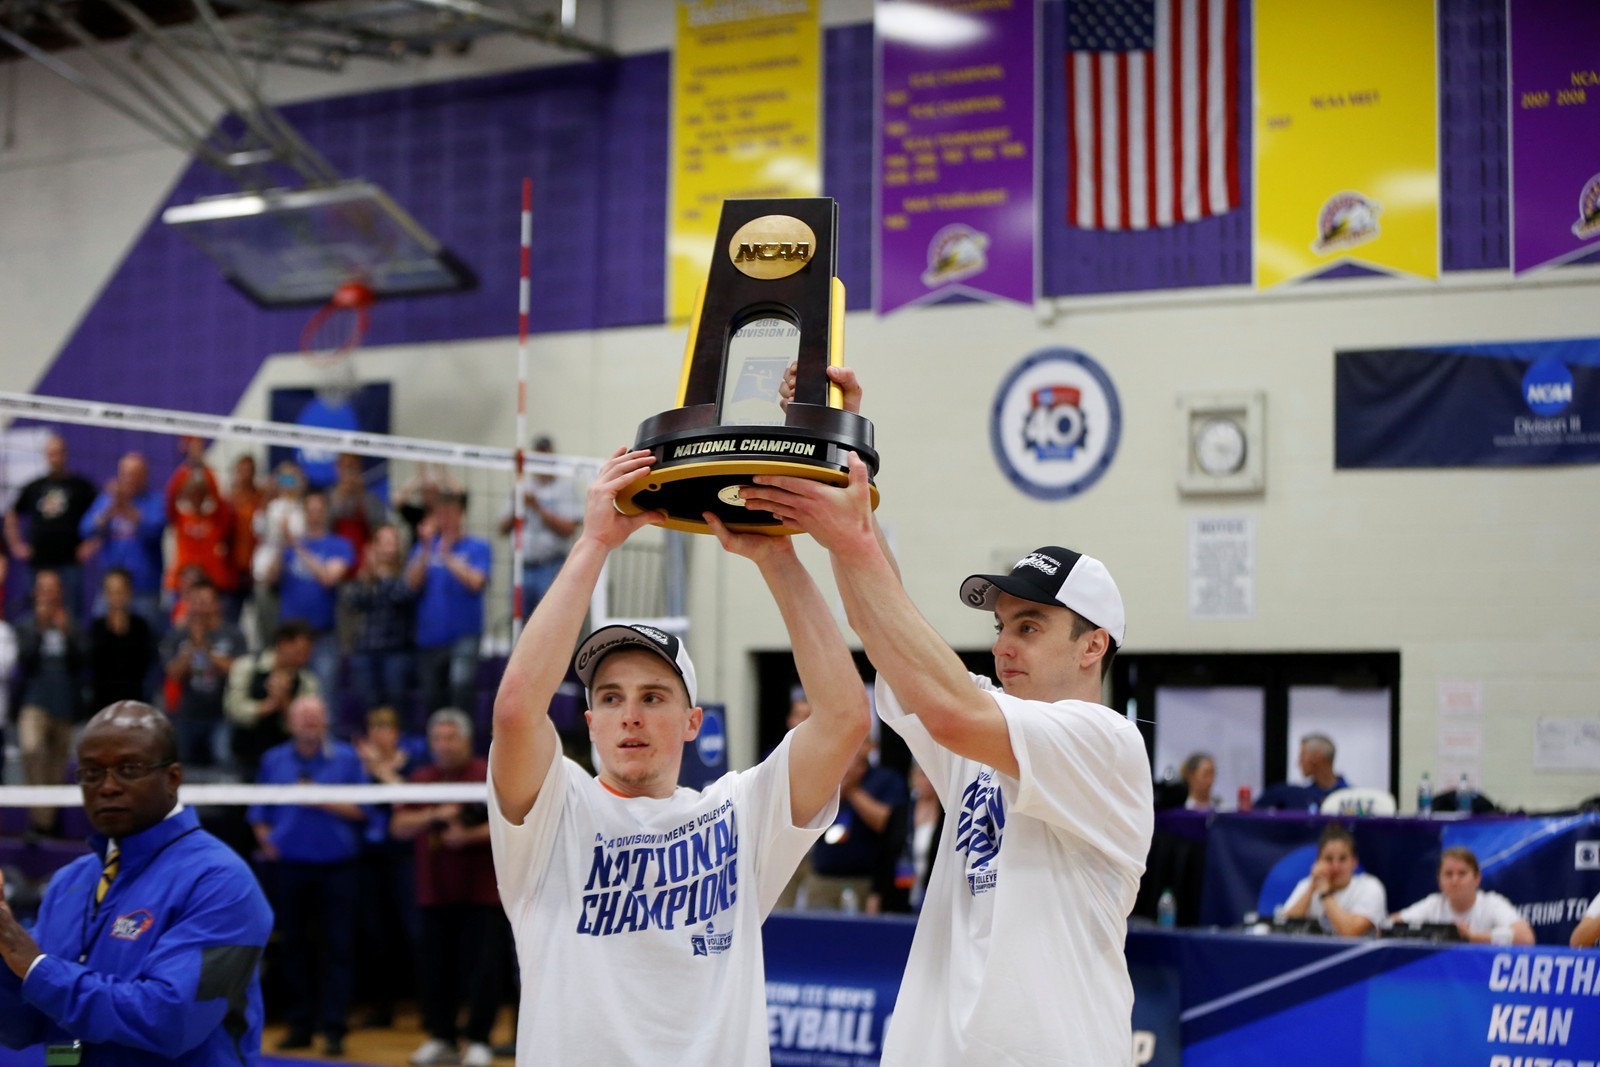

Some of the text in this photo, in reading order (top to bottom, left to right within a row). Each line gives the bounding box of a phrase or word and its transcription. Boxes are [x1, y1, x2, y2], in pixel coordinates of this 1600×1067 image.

[1571, 70, 1600, 87] NCA
[734, 242, 810, 263] NCAA
[735, 327, 784, 338] DIVISION
[755, 319, 779, 328] 2016
[1527, 382, 1573, 404] NCAA
[1027, 402, 1083, 447] 40
[673, 439, 816, 459] NATIONAL CHAMPION
[616, 834, 656, 849] DIVISION
[663, 820, 695, 843] MEN'S
[583, 809, 739, 892] NATIONAL
[766, 1004, 876, 1056] EYBALL
[1487, 1003, 1574, 1047] KEAN
